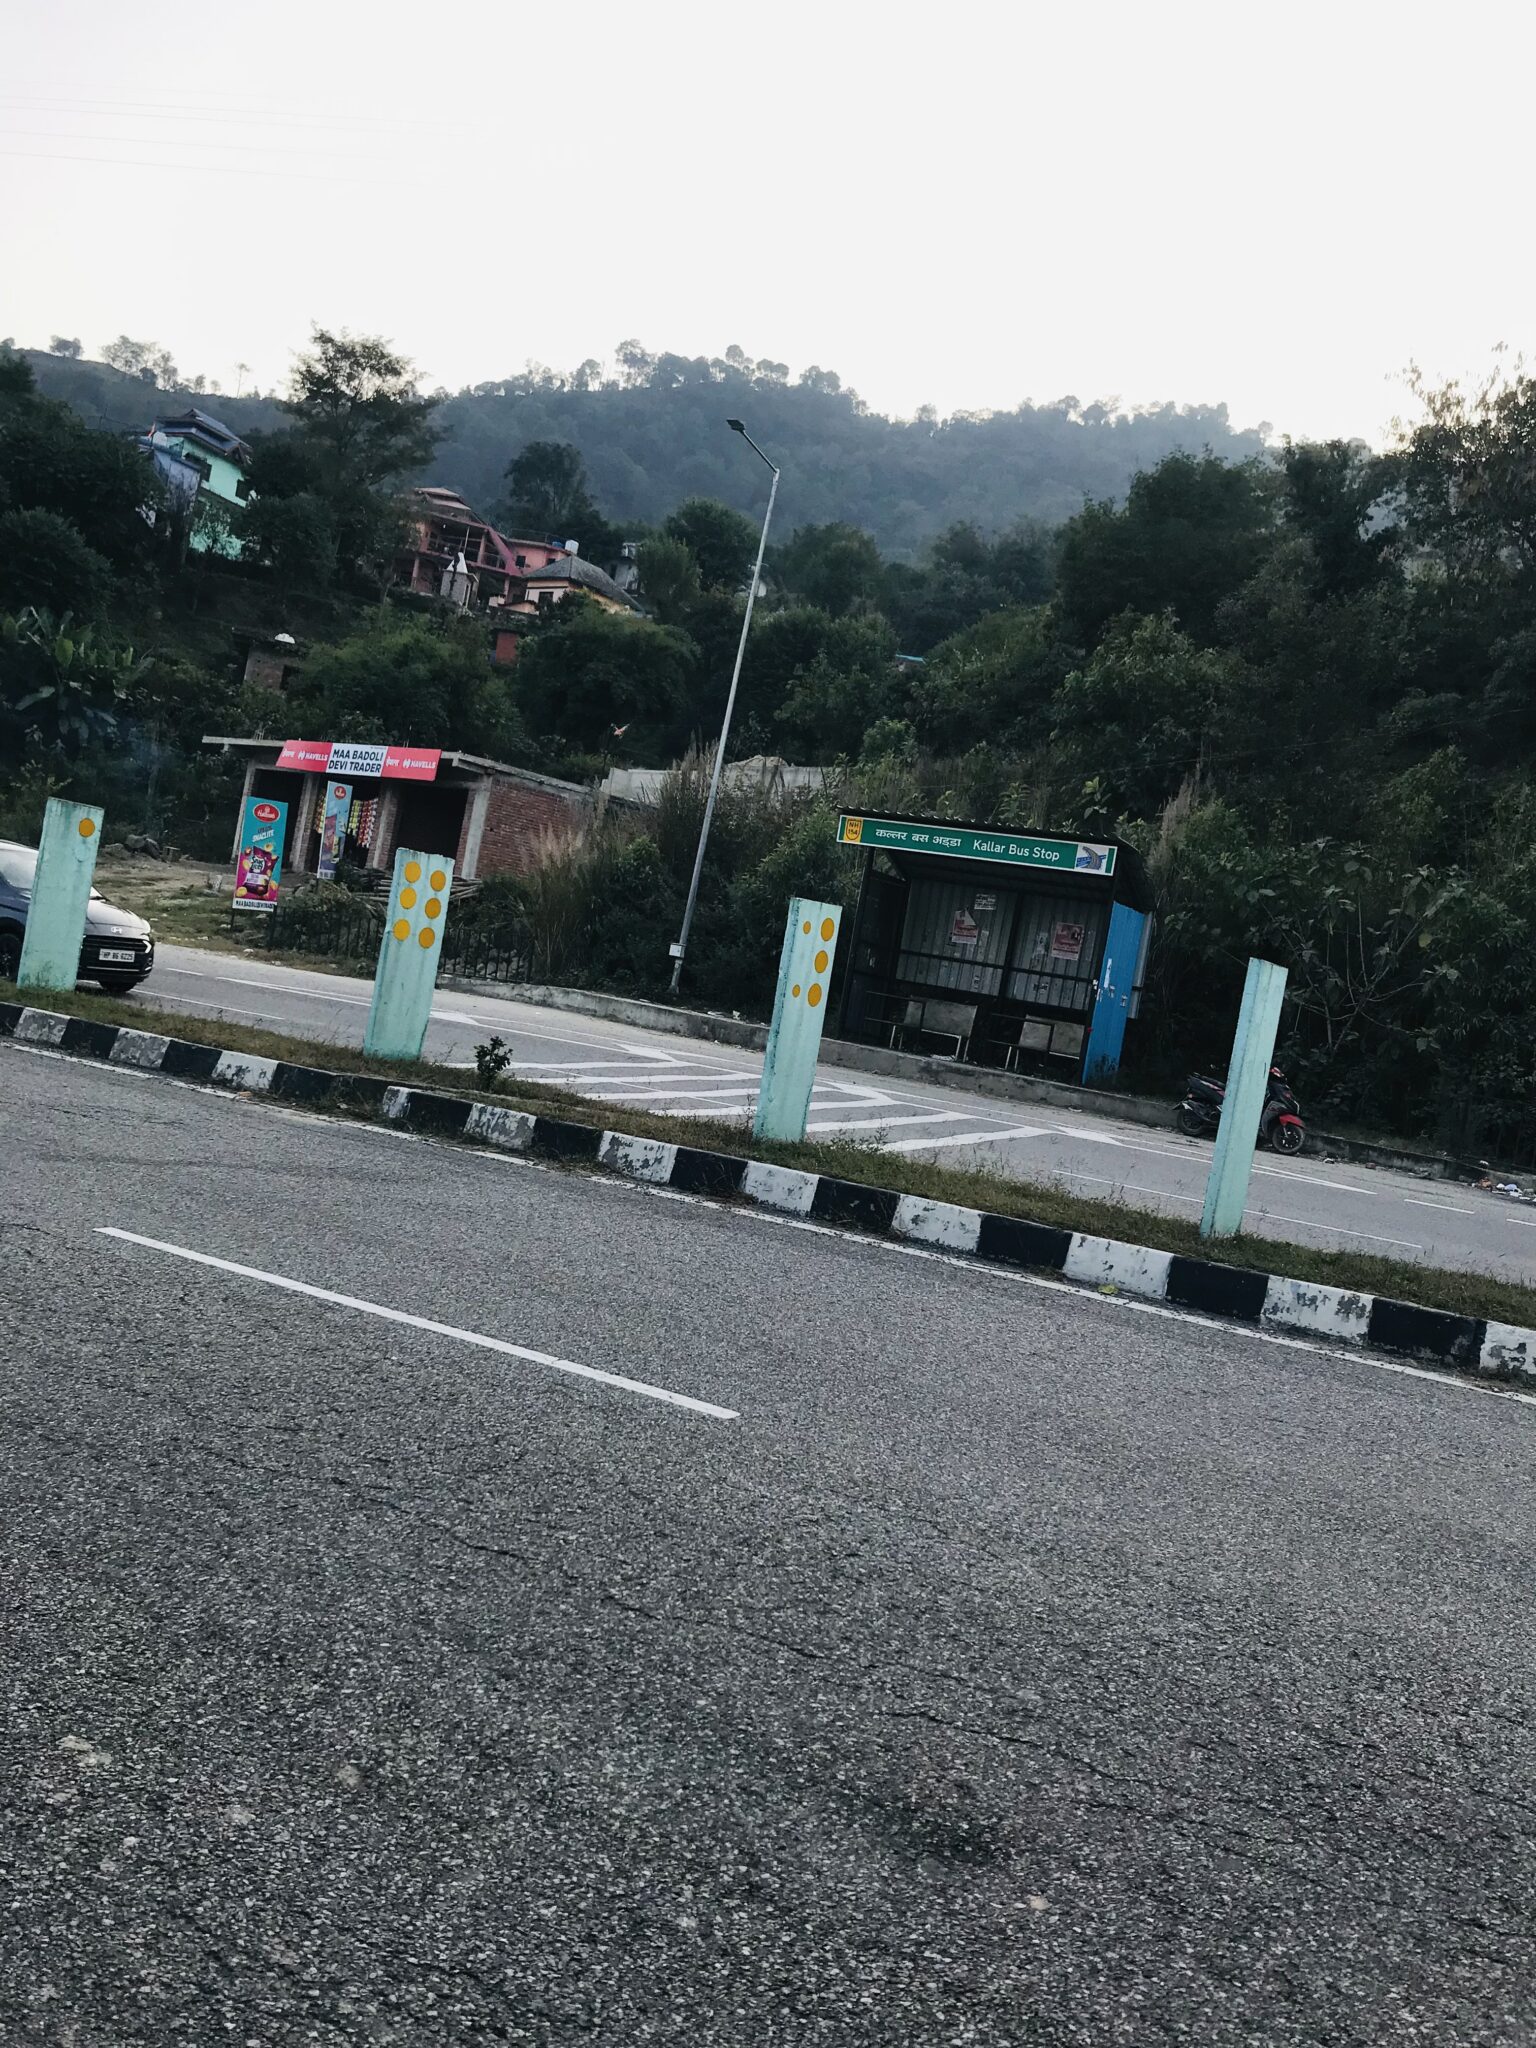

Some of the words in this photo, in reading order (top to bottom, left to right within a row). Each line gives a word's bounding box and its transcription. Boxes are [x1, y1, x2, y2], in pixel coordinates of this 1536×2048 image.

[305, 753, 328, 761] HAVELLS
[333, 749, 350, 759] MAA
[352, 750, 384, 761] BADOLI
[328, 760, 348, 770] DEVI
[350, 762, 381, 773] TRADER
[410, 760, 436, 769] HAVELLS
[876, 828, 908, 840] कल्लर
[912, 834, 929, 842] बस
[973, 840, 1006, 854] Kallar
[1008, 844, 1030, 858] Bus
[1032, 847, 1060, 862] Stop
